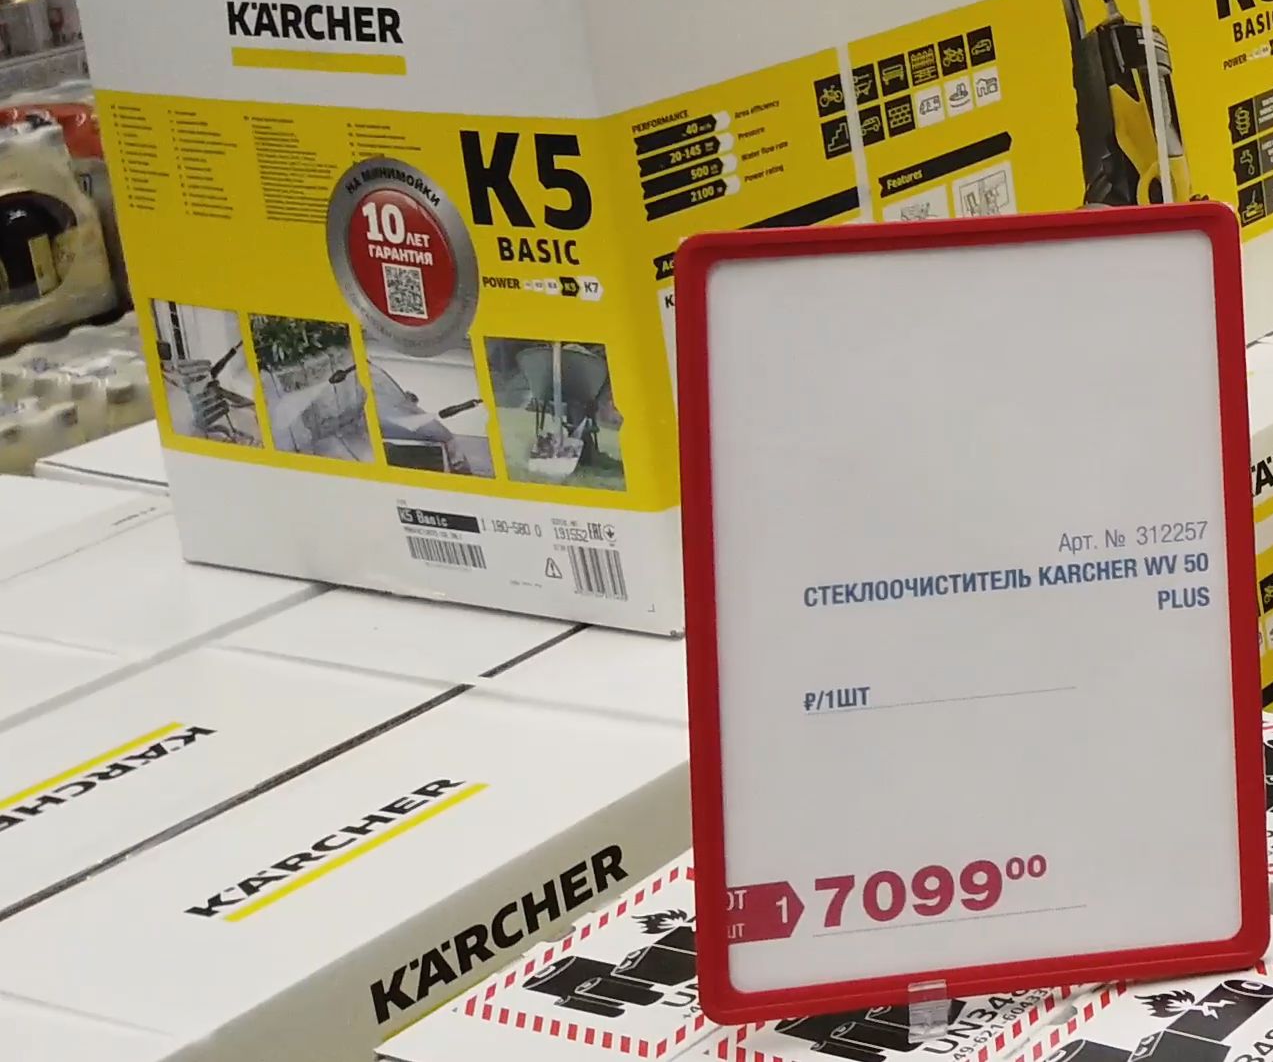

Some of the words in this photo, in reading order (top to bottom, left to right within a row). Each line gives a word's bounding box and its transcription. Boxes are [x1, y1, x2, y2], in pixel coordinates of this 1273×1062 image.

[226, 0, 403, 43] KÄRCHER
[1223, 54, 1247, 71] POWER
[632, 110, 689, 133] PERFORMANCE
[685, 124, 698, 135] 40
[751, 100, 780, 115] efficiency
[738, 127, 765, 140] Pressure
[363, 167, 440, 207] МИНИМОЙКИ
[459, 130, 593, 230] K5
[690, 186, 714, 202] 2100
[765, 164, 784, 177] rating
[691, 168, 709, 180] 500
[886, 168, 923, 192] Features
[362, 201, 405, 244] 10
[406, 233, 430, 248] ЛЕТ
[368, 244, 433, 266] ГАРАНТИЯ
[497, 236, 580, 265] BASIC
[483, 276, 520, 289] POWER
[584, 281, 598, 293] K7
[416, 510, 448, 528] Basic
[1059, 530, 1097, 554] Арт.
[1105, 528, 1125, 548] №
[1136, 521, 1209, 545] 312257
[804, 569, 1031, 607] СТЕКЛООЧИСТИТЕЛЬ
[1039, 558, 1137, 586] KARCHER
[1144, 555, 1178, 577] WV
[1184, 552, 1209, 573] 50
[1158, 587, 1210, 611] PLUS
[0, 726, 217, 832] KÄRCHE
[183, 777, 466, 918] KÄRCHER
[776, 895, 789, 924] 1
[815, 860, 1002, 928] 7099
[370, 843, 628, 1026] KÄRCHER
[922, 987, 1030, 1058] UN34
